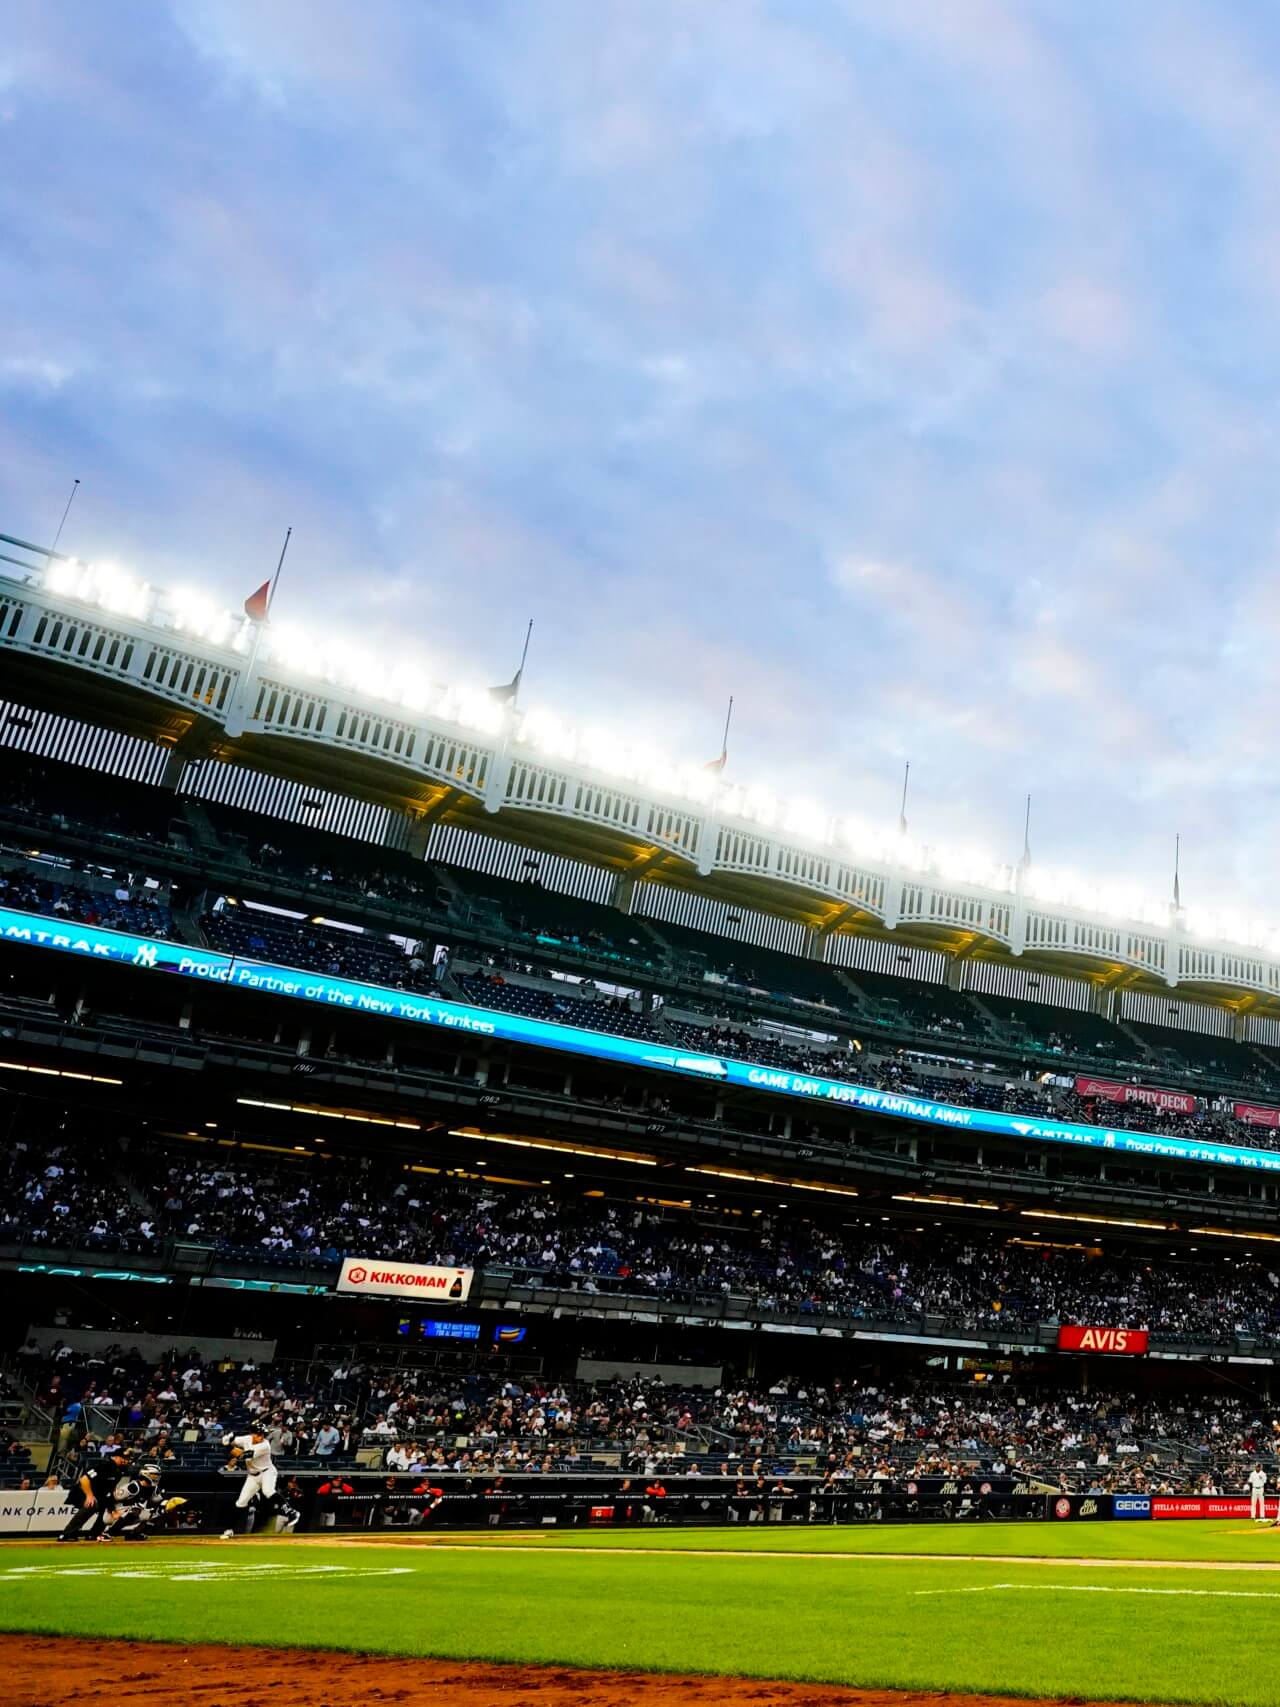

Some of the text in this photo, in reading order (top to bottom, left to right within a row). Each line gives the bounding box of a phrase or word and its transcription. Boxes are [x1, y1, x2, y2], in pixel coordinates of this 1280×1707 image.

[178, 957, 495, 1034] Proud Partner of the New York Yankees
[748, 1069, 788, 1089] GAME
[791, 1077, 821, 1096] DAY.
[825, 1085, 856, 1103] JUST
[858, 1090, 879, 1107] AN
[880, 1094, 931, 1118] AMTRAK
[1125, 1088, 1158, 1105] PARTY
[1160, 1094, 1188, 1110] DECK
[1031, 1128, 1094, 1143] AMTRAK
[1126, 1139, 1153, 1151] Proud
[1155, 1143, 1187, 1156] Partner
[1217, 1151, 1236, 1163] New
[370, 1271, 448, 1288] KIKKOMAN
[1080, 1329, 1127, 1350] AVIS
[27, 1506, 43, 1516] OF
[47, 1507, 80, 1516] AME
[1116, 1501, 1150, 1510] GEICO
